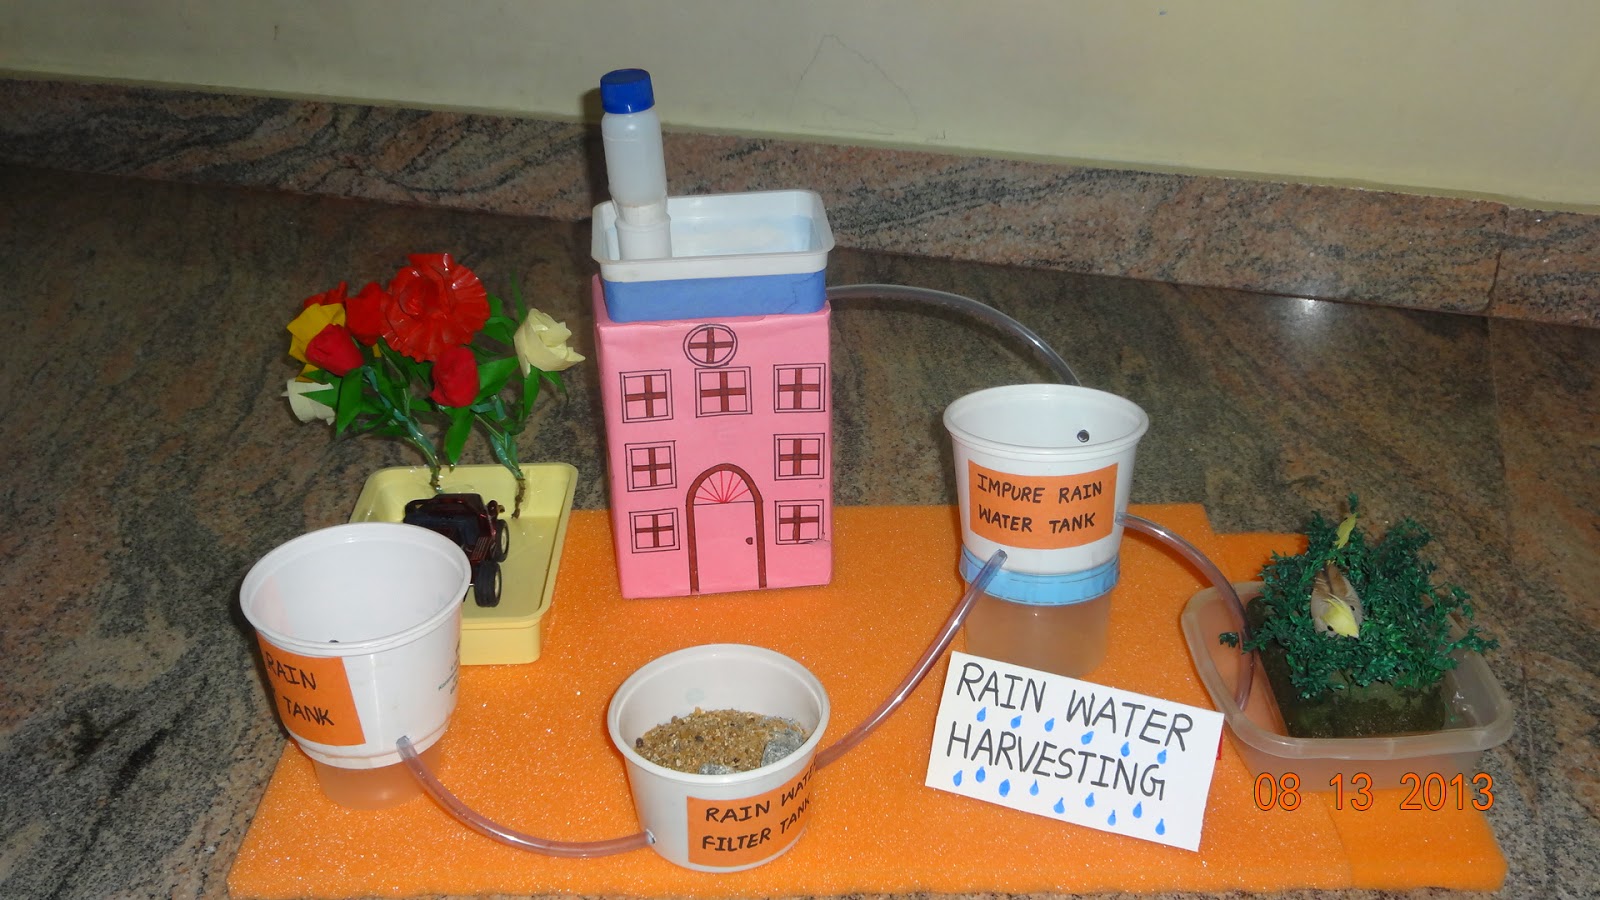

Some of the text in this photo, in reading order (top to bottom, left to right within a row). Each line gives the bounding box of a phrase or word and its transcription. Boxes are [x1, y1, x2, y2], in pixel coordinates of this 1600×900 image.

[977, 473, 1103, 504] IMPURE RAIN
[978, 504, 1096, 534] WATER TANK
[264, 651, 317, 690] RAIN
[282, 695, 335, 726] TANK
[956, 662, 1194, 752] RAIN WATER
[946, 720, 1166, 801] HARVESTING
[702, 792, 811, 851] FILTER TANK
[705, 800, 771, 823] RAIN
